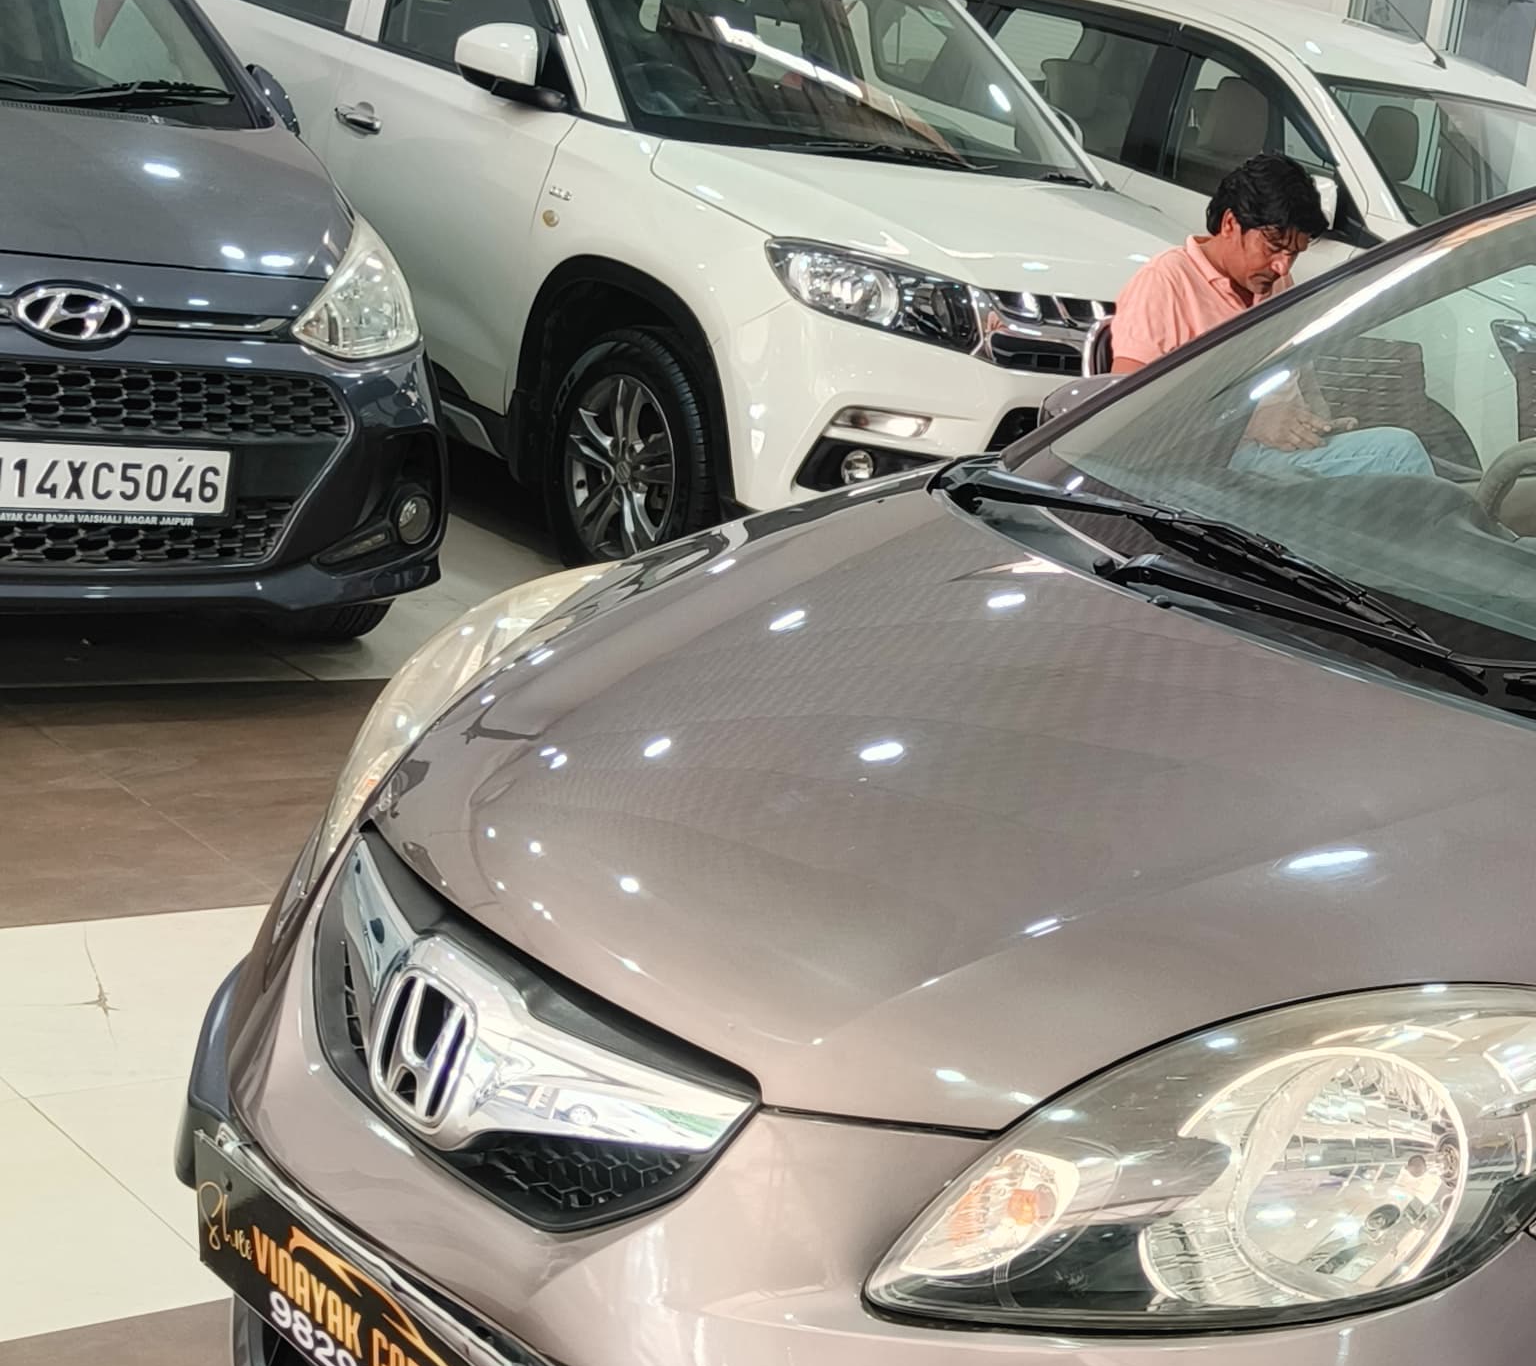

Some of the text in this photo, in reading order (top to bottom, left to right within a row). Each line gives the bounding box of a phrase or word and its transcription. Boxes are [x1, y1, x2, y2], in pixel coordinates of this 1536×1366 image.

[0, 457, 220, 503] 14XC5046
[25, 513, 44, 523] CAR
[45, 514, 75, 524] BAZAR
[77, 515, 122, 525] VAISHALI
[124, 516, 158, 526] NAGAR
[159, 517, 194, 527] JAIPUR
[252, 1225, 363, 1359] VINAYAK
